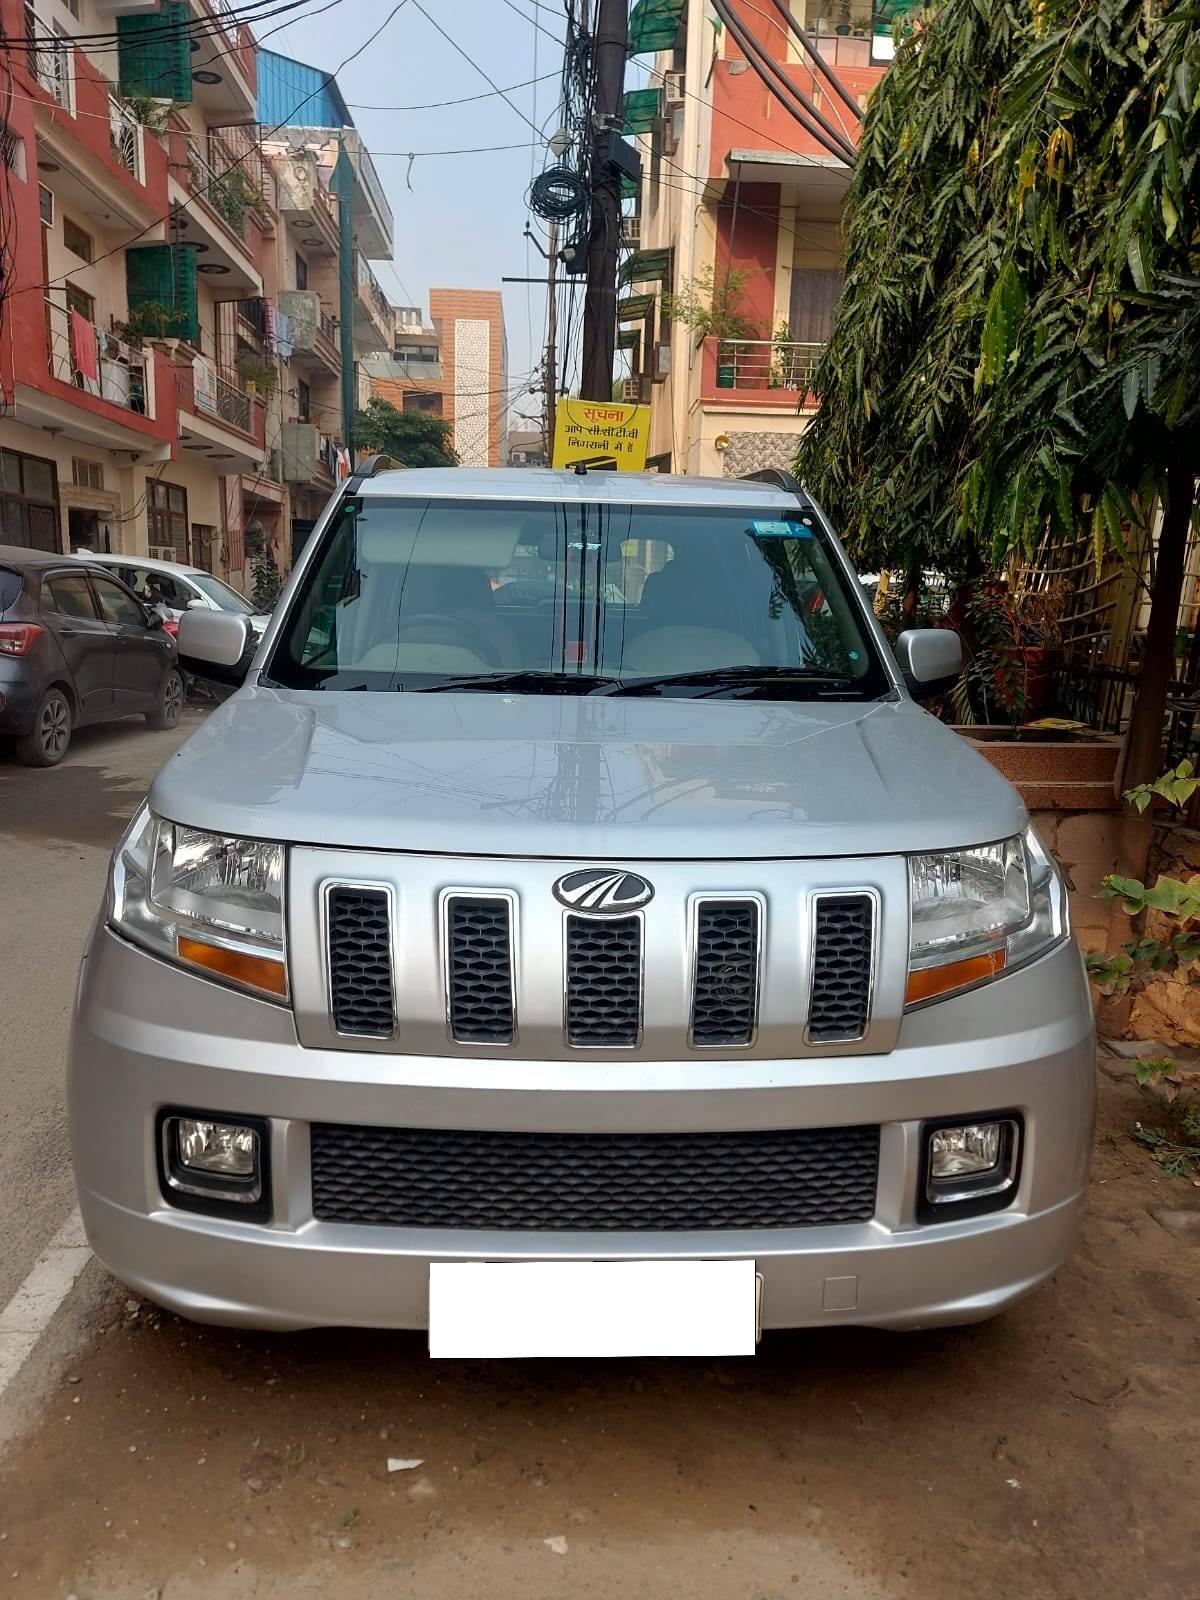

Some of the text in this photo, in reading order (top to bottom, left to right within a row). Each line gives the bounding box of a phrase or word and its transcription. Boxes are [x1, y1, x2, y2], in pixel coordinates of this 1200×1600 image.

[584, 407, 624, 423] सूचना
[565, 425, 582, 433] आप
[568, 437, 609, 450] निगरानी
